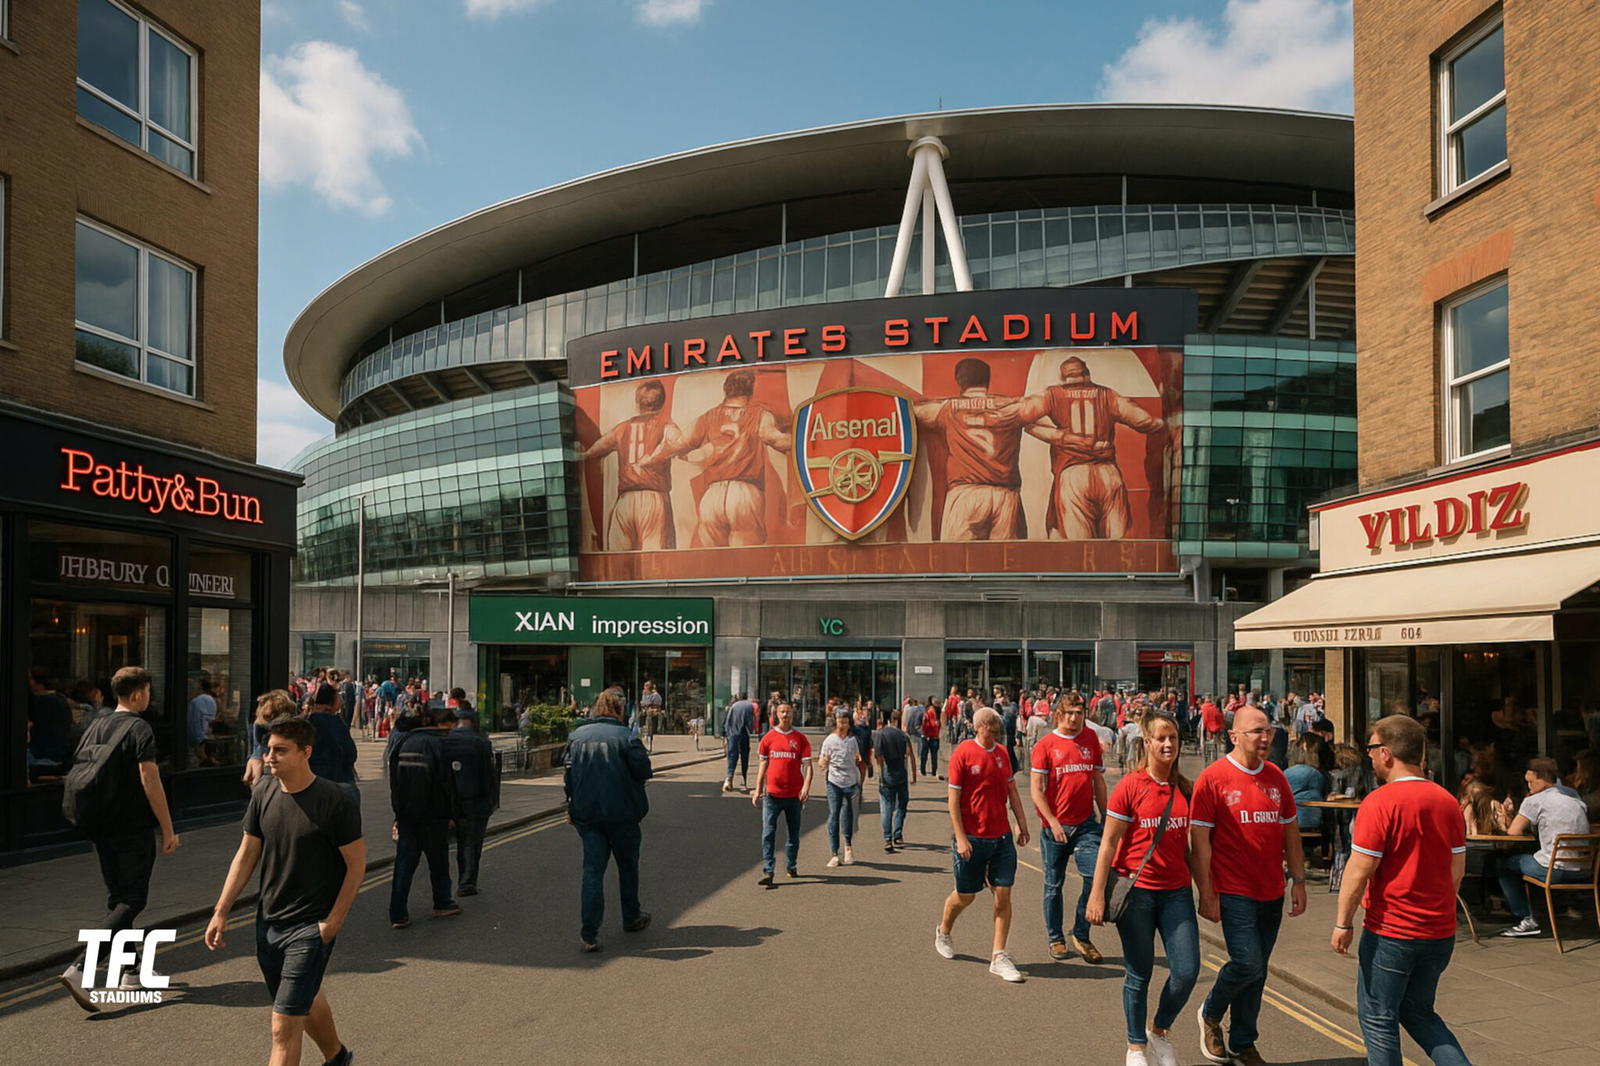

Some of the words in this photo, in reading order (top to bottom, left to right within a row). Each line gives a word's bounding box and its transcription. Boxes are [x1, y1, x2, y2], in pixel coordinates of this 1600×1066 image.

[600, 325, 847, 378] EMIRATES
[884, 312, 1138, 346] STADIUM
[810, 411, 897, 441] Arsenal
[60, 448, 264, 524] Patty&Bun
[1358, 482, 1530, 552] YILDIZ
[514, 611, 575, 631] XIAN
[592, 616, 709, 637] impression
[818, 617, 844, 636] YC
